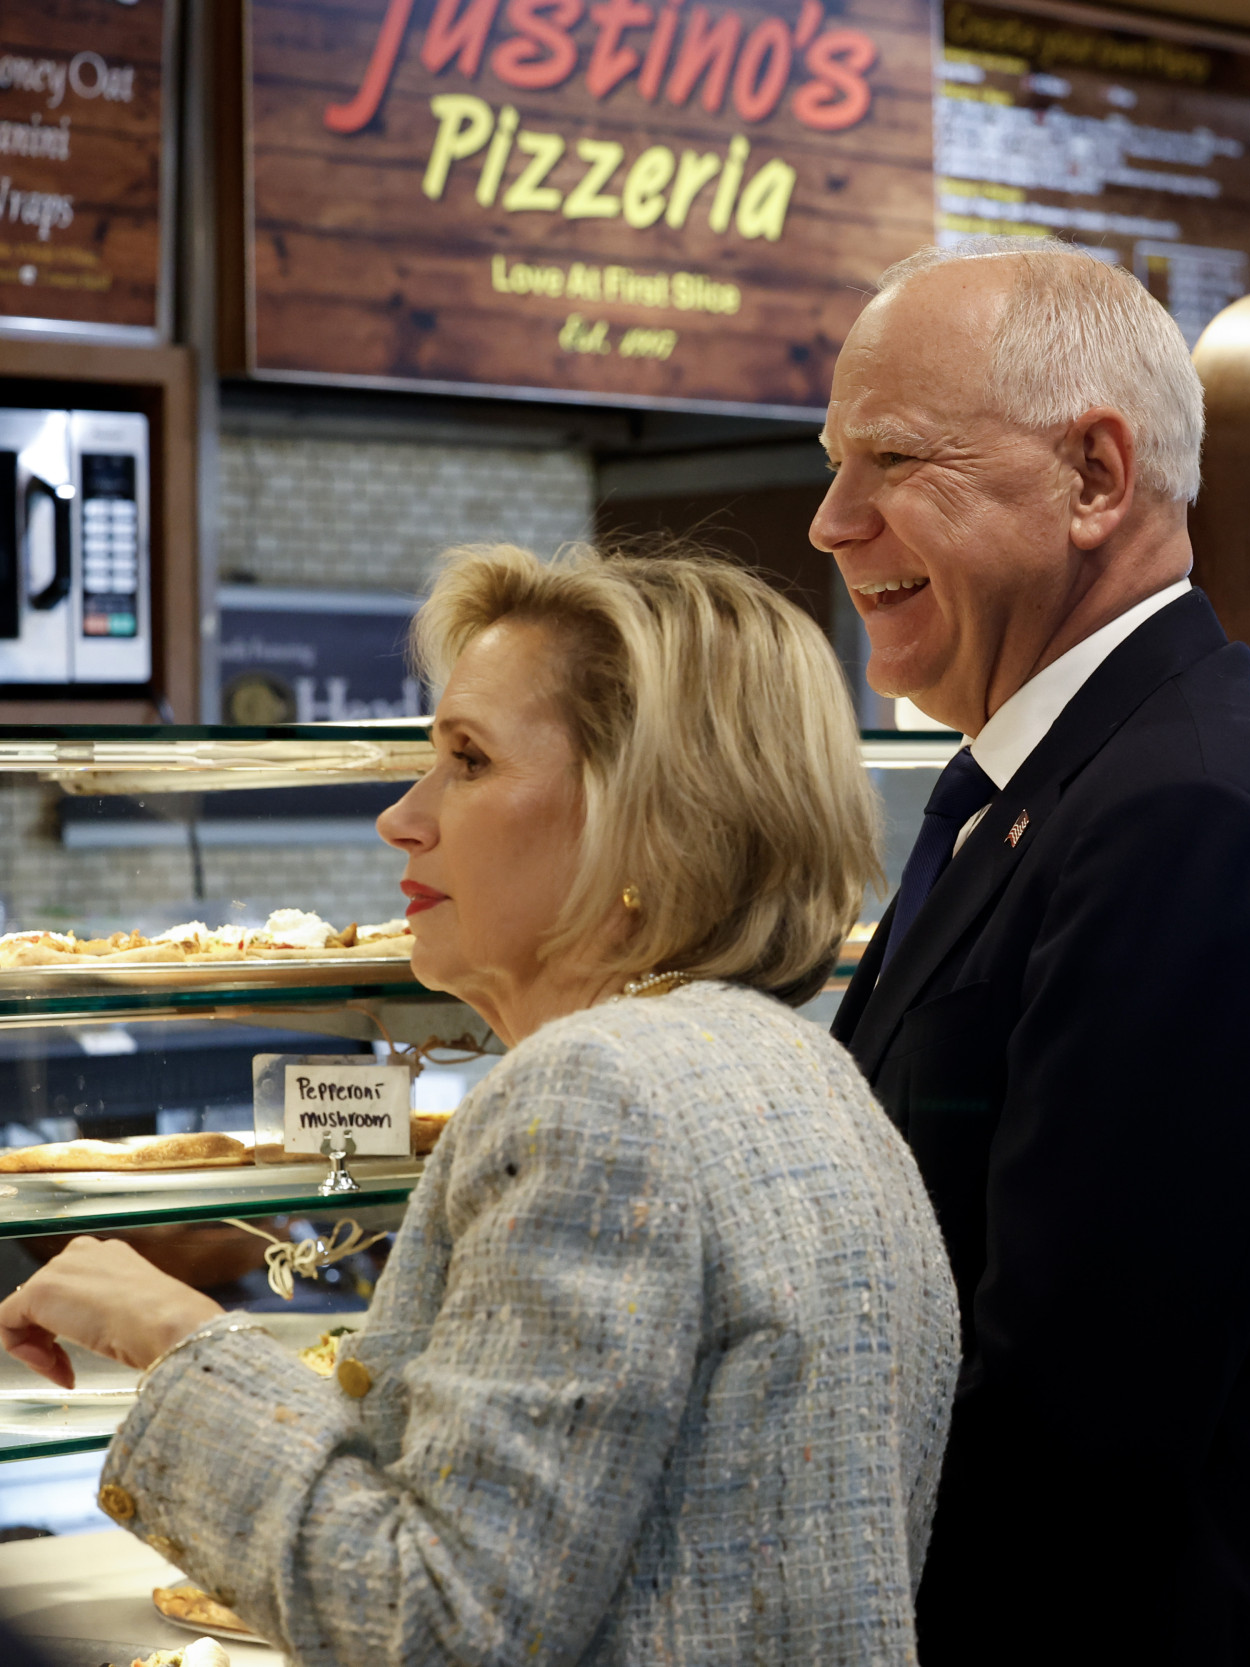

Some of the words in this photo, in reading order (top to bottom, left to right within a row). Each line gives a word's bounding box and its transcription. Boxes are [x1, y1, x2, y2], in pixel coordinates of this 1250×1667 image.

[324, 0, 877, 133] Justino's
[421, 94, 796, 241] Pizzeria
[491, 253, 565, 298] Love
[566, 261, 602, 302] At
[602, 265, 670, 310] First
[671, 271, 742, 316] Slice
[296, 1076, 385, 1102] Pepperoni
[299, 1110, 392, 1129] mushroom
